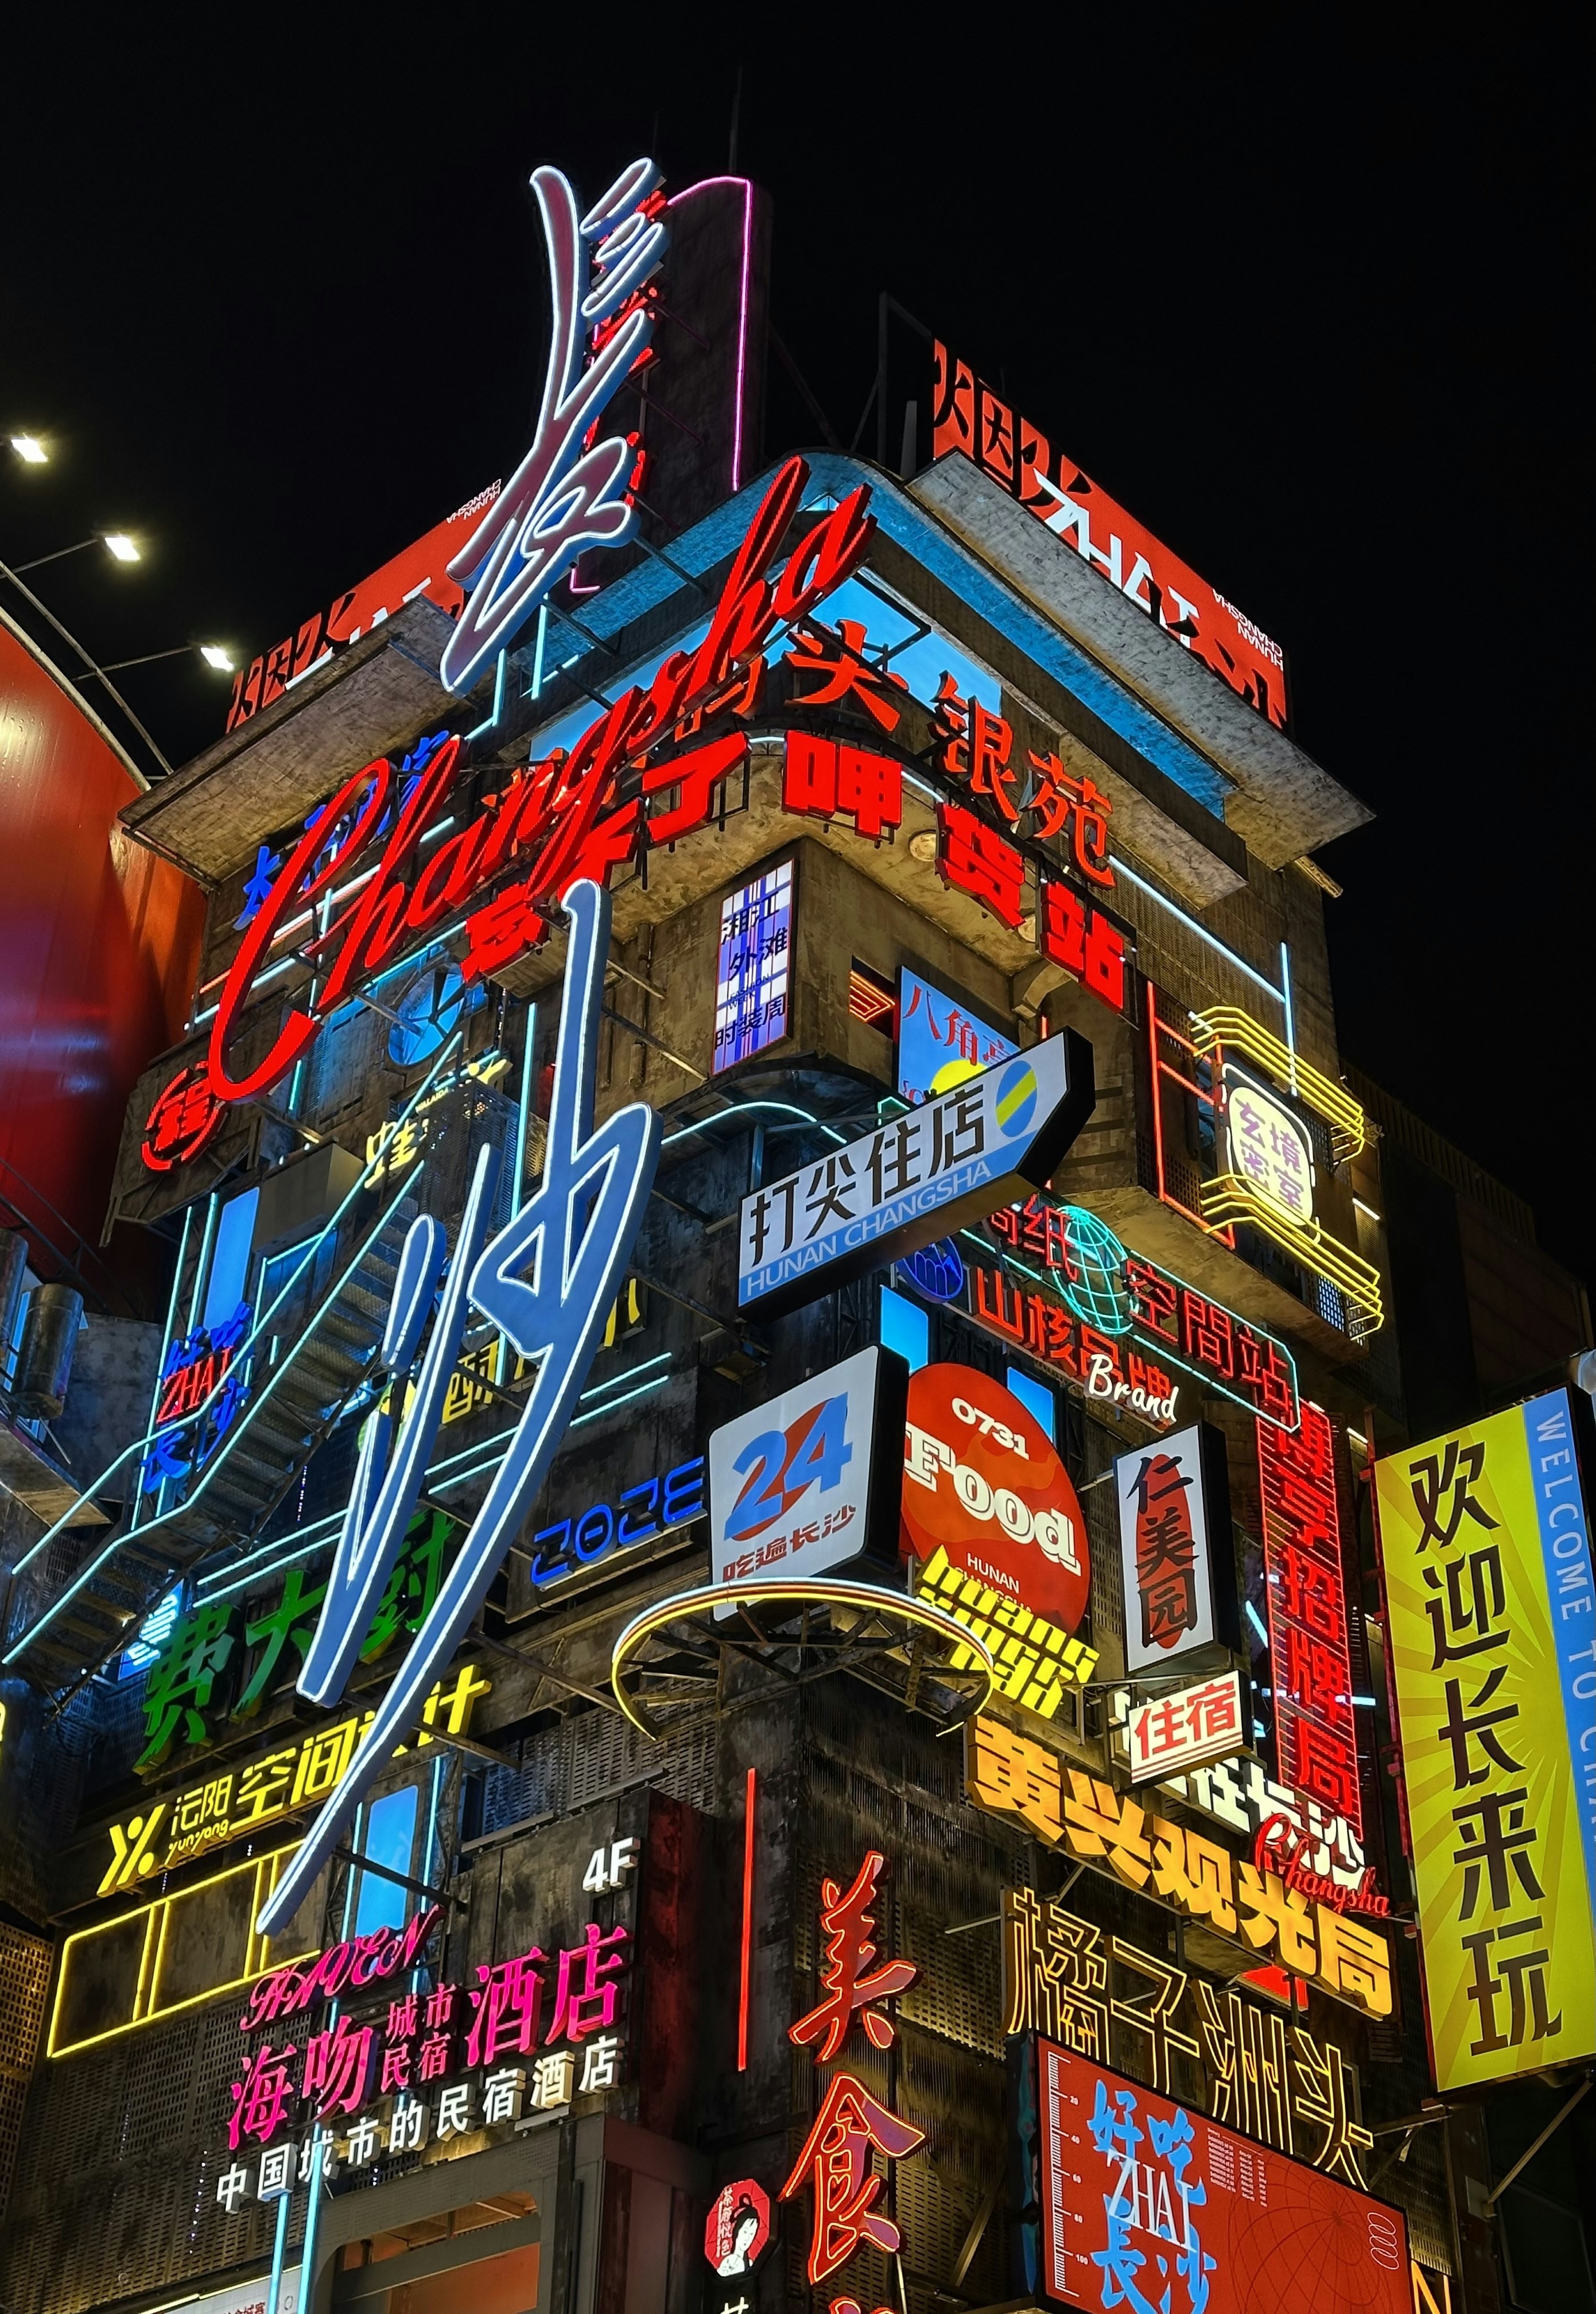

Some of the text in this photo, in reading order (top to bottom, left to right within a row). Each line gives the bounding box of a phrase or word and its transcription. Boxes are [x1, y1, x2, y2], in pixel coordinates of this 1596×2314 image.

[205, 452, 877, 1105] Changsha
[721, 891, 779, 945] 湘江
[729, 927, 787, 981] 外滩
[714, 996, 785, 1050] 时装周
[729, 991, 756, 1010] WEEK
[730, 973, 770, 1000] FASHION
[750, 1085, 985, 1267] 打尖住店
[844, 1159, 992, 1247] CHANGSHA
[747, 1236, 837, 1297] HUNAN
[952, 1396, 1030, 1461] 0731
[1088, 1353, 1179, 1423] Brand
[723, 1391, 853, 1541] 24
[904, 1422, 1082, 1577] Food
[722, 1504, 856, 1583] 吃遍长沙
[1126, 1455, 1199, 1649] 仁美园
[1536, 1410, 1592, 1621] WELCOME
[967, 1552, 1019, 1594] HUNAN
[1135, 1679, 1237, 1761] 住宿
[1409, 1439, 1562, 2057] 欢迎长来玩
[583, 1837, 639, 1893] 4F
[974, 1715, 1393, 2021] 黄兴观光局
[1255, 1812, 1392, 1917] Changsha
[227, 1923, 632, 2151] 海吻 城市 酒店
[380, 2029, 452, 2095] 民宿
[778, 1850, 931, 2314] 美食
[1008, 1886, 1373, 2192] 橘子洲头
[215, 2035, 619, 2214] 中国城市的民宿酒店
[1107, 2148, 1197, 2254] ZHAI
